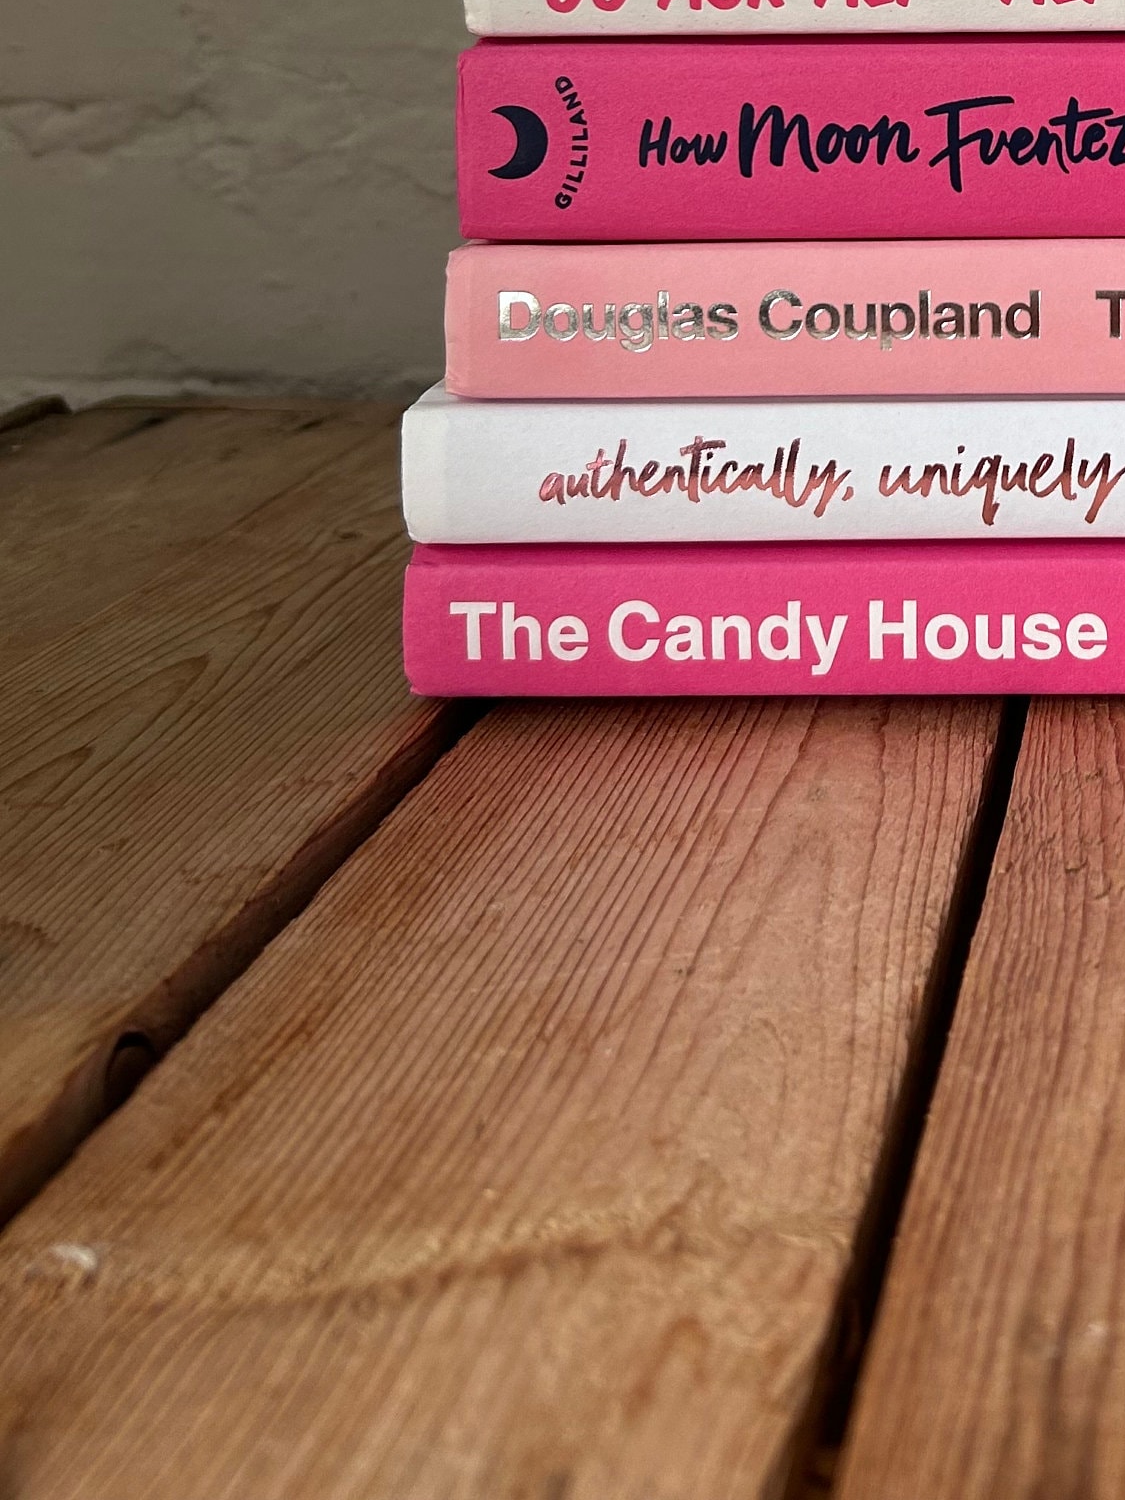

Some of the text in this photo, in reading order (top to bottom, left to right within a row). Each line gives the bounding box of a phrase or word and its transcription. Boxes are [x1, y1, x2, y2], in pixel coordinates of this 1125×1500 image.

[555, 76, 588, 209] GILLILAND
[639, 117, 727, 167] How
[739, 103, 920, 178] Moon
[498, 289, 1042, 352] Douglas Coupland
[539, 436, 853, 517] authentically,
[450, 600, 1107, 675] The Candy House
